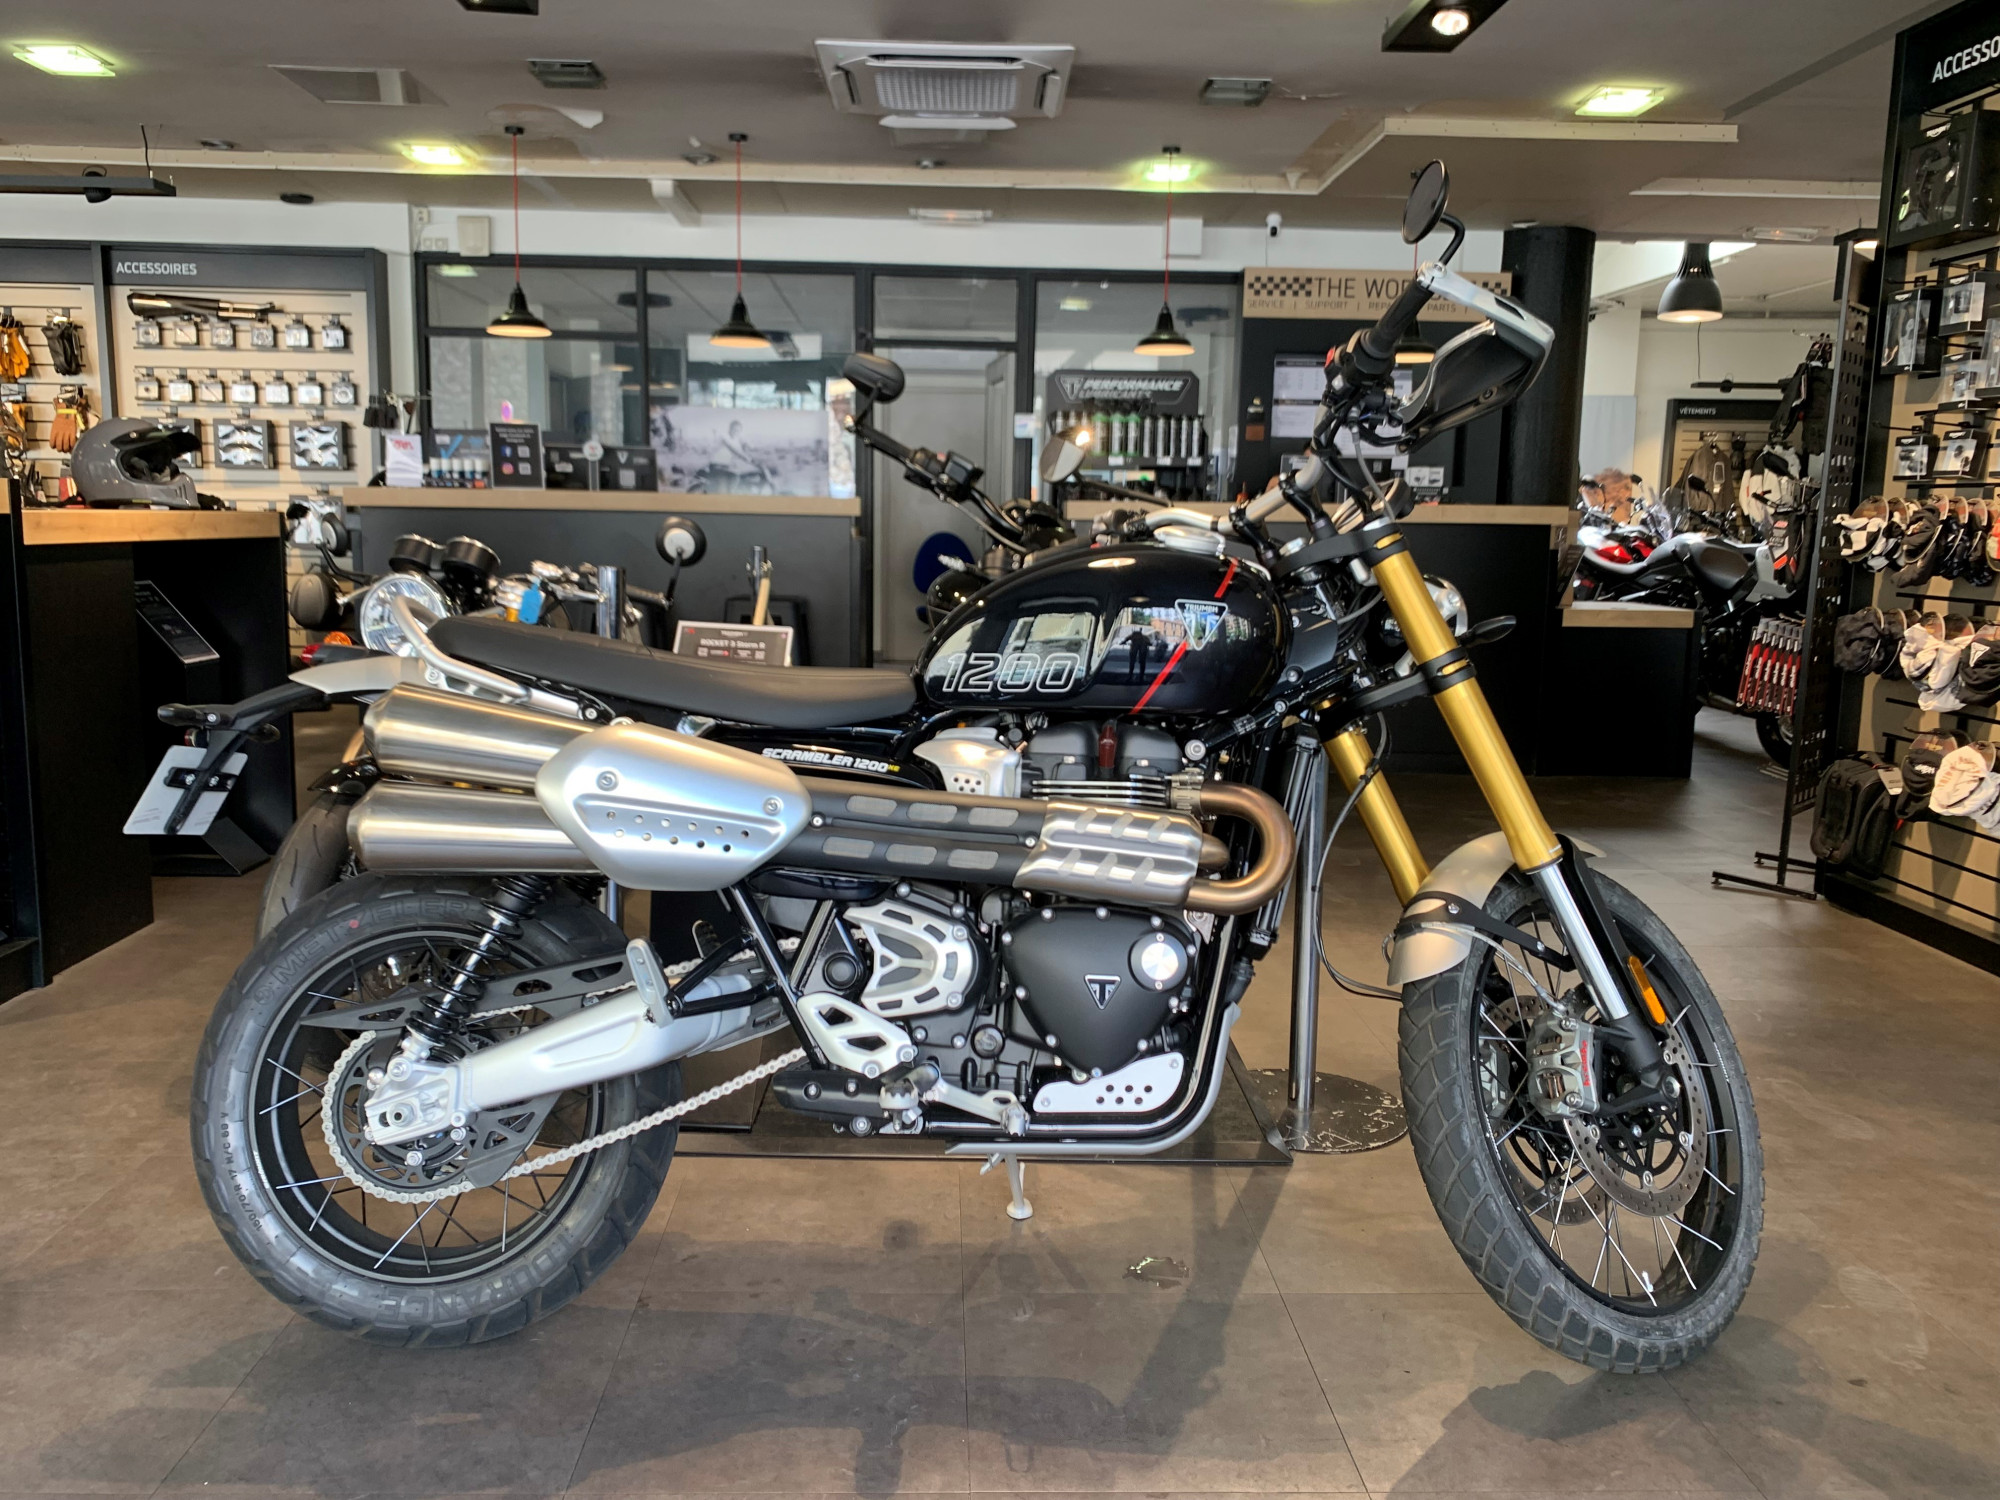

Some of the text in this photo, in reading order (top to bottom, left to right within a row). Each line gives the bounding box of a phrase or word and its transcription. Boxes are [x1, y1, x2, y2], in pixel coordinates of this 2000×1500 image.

[1931, 35, 2000, 83] ACCESSO
[116, 261, 198, 276] ACCESSOIRES
[1313, 276, 1356, 299] THE
[1248, 299, 1285, 310] SERVICE
[1305, 300, 1348, 311] SUPPORT
[1427, 303, 1456, 313] PARTS
[1083, 379, 1184, 392] PERFORMANCE
[1184, 603, 1219, 614] TRIUMPH
[700, 638, 729, 648] ROCKET
[942, 652, 1080, 693] 1200
[762, 747, 853, 768] SCRAMBLER
[853, 757, 888, 774] 1200
[1580, 1039, 1591, 1088] brembo
